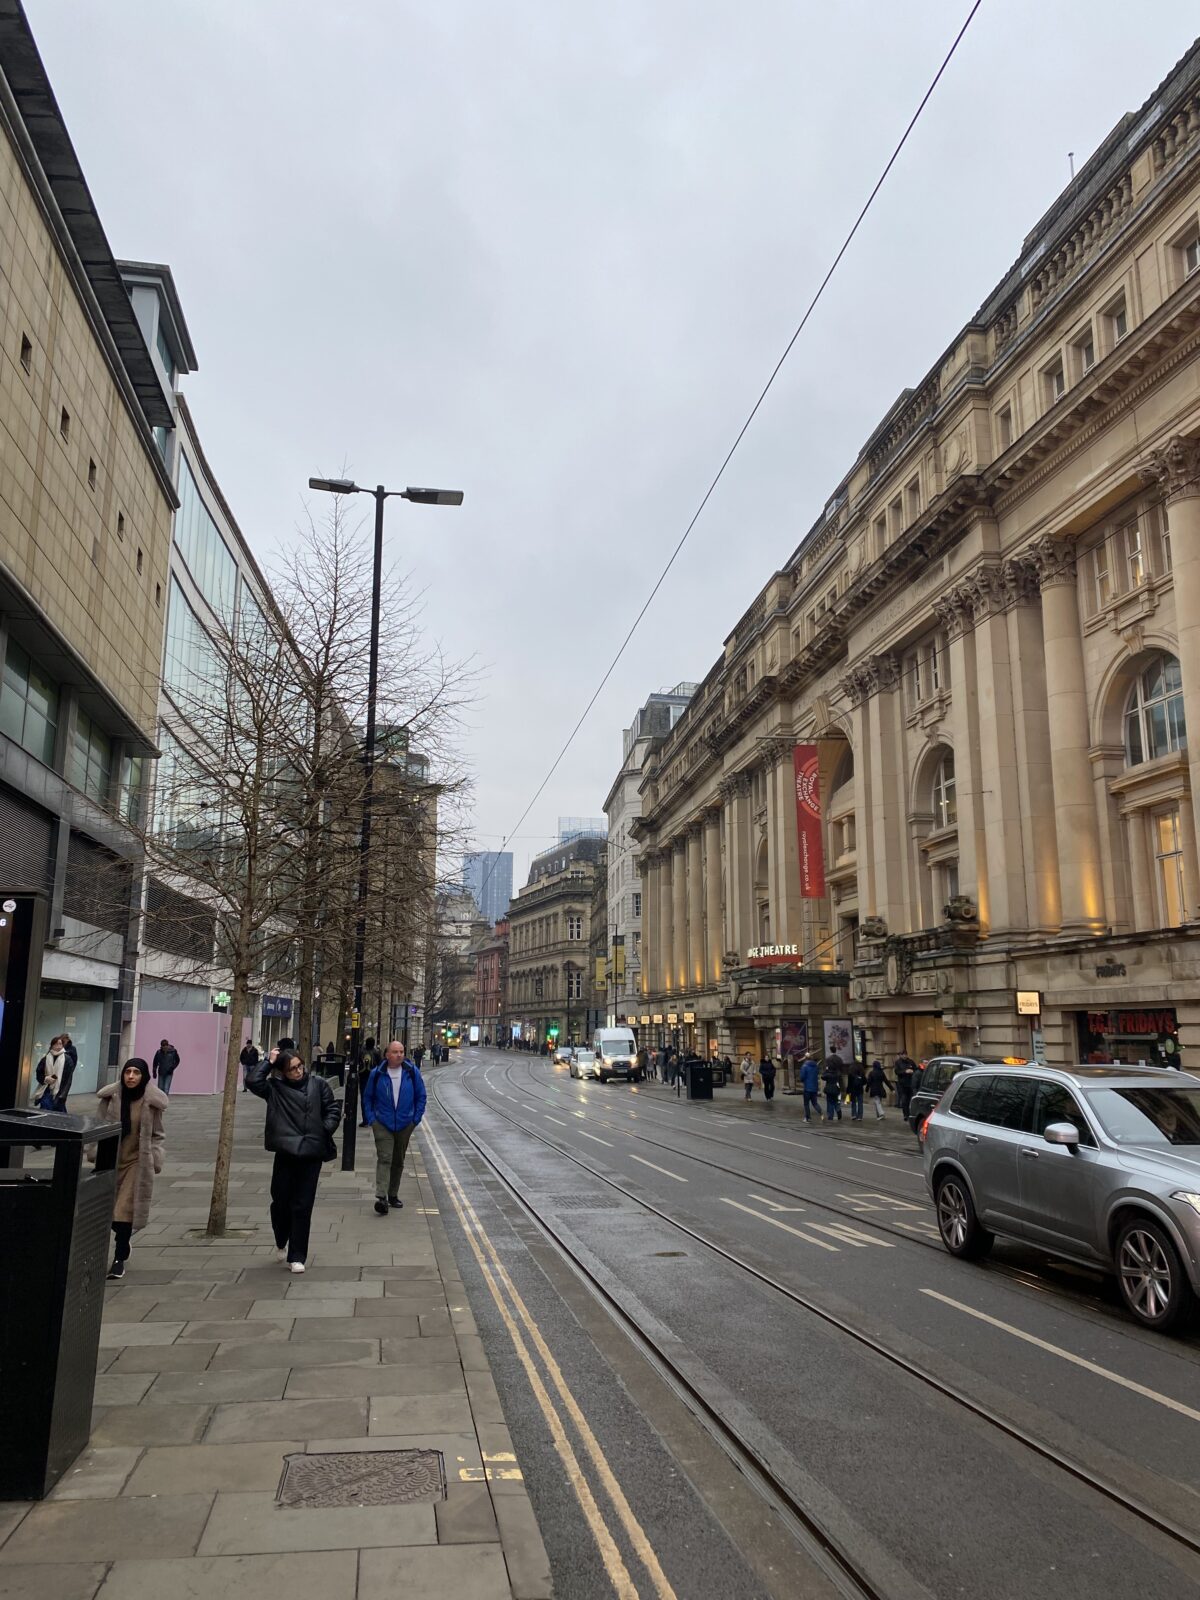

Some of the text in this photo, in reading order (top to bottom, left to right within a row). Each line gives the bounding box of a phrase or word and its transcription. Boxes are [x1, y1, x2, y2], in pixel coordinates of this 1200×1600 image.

[796, 770, 804, 801] THEATRE
[802, 777, 819, 811] EXCHANGE
[808, 772, 818, 794] ROYAL
[760, 944, 797, 957] THEATRE
